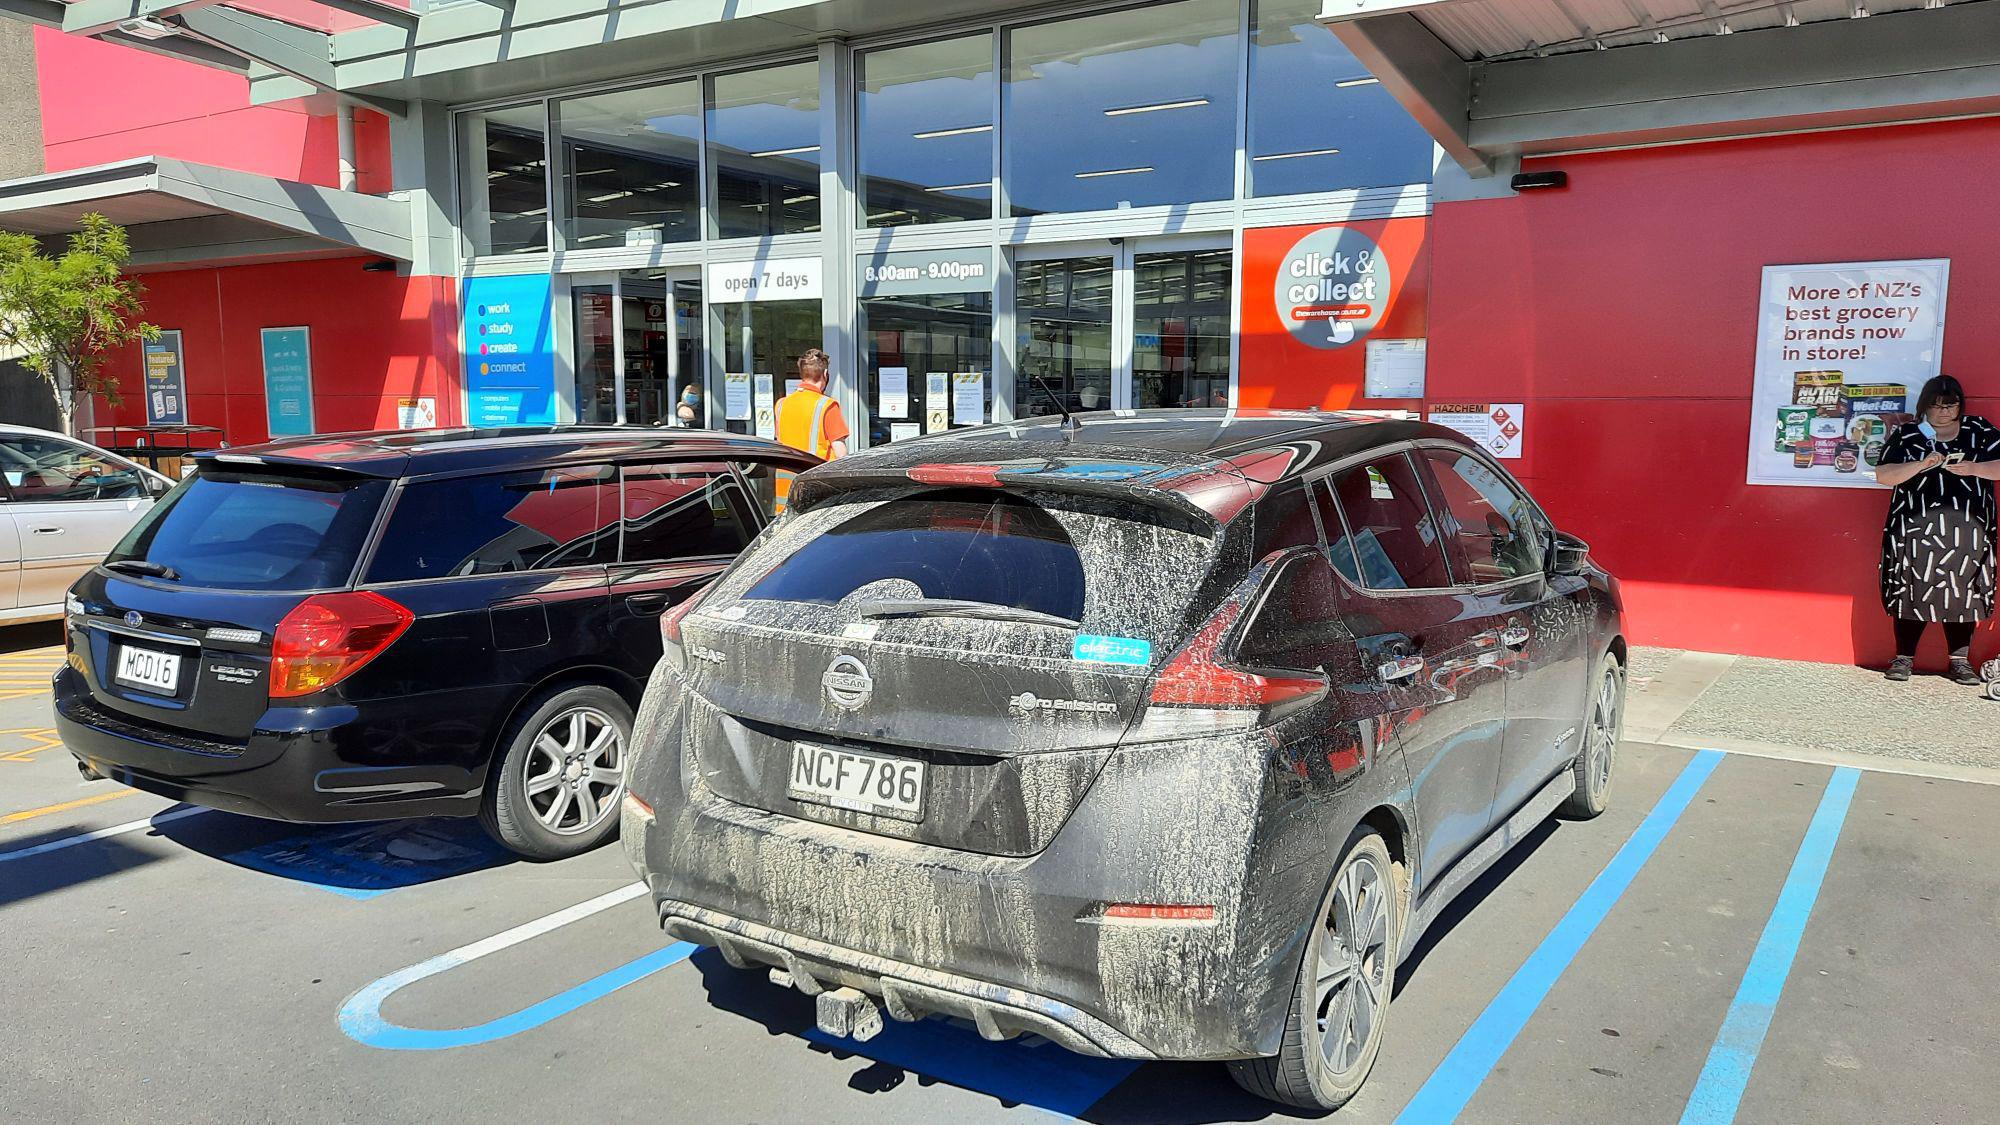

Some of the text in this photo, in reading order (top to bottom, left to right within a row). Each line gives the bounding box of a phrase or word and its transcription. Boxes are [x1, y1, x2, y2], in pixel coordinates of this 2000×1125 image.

[864, 265, 919, 282] 8.00am
[928, 261, 984, 281] 9.00pm
[1290, 249, 1376, 278] click &
[725, 271, 809, 291] open 7 days
[1287, 276, 1376, 303] collect
[1788, 282, 1922, 301] More of NZ's
[487, 303, 511, 314] work
[1785, 304, 1920, 324] best grocery
[488, 322, 514, 336] study
[1784, 324, 1906, 341] brands now
[489, 343, 518, 354] create
[1782, 344, 1867, 361] in store!
[490, 361, 527, 373] connect
[1434, 404, 1485, 413] HAZCHEM
[1796, 395, 1838, 405] GRAIN
[1852, 400, 1901, 411] Weet-Bix
[691, 643, 726, 664] LEAF
[1079, 637, 1144, 658] electric
[126, 650, 172, 684] MCD16
[210, 664, 262, 677] LEGACY
[826, 676, 866, 689] NISSAN
[795, 747, 918, 804] NCF786
